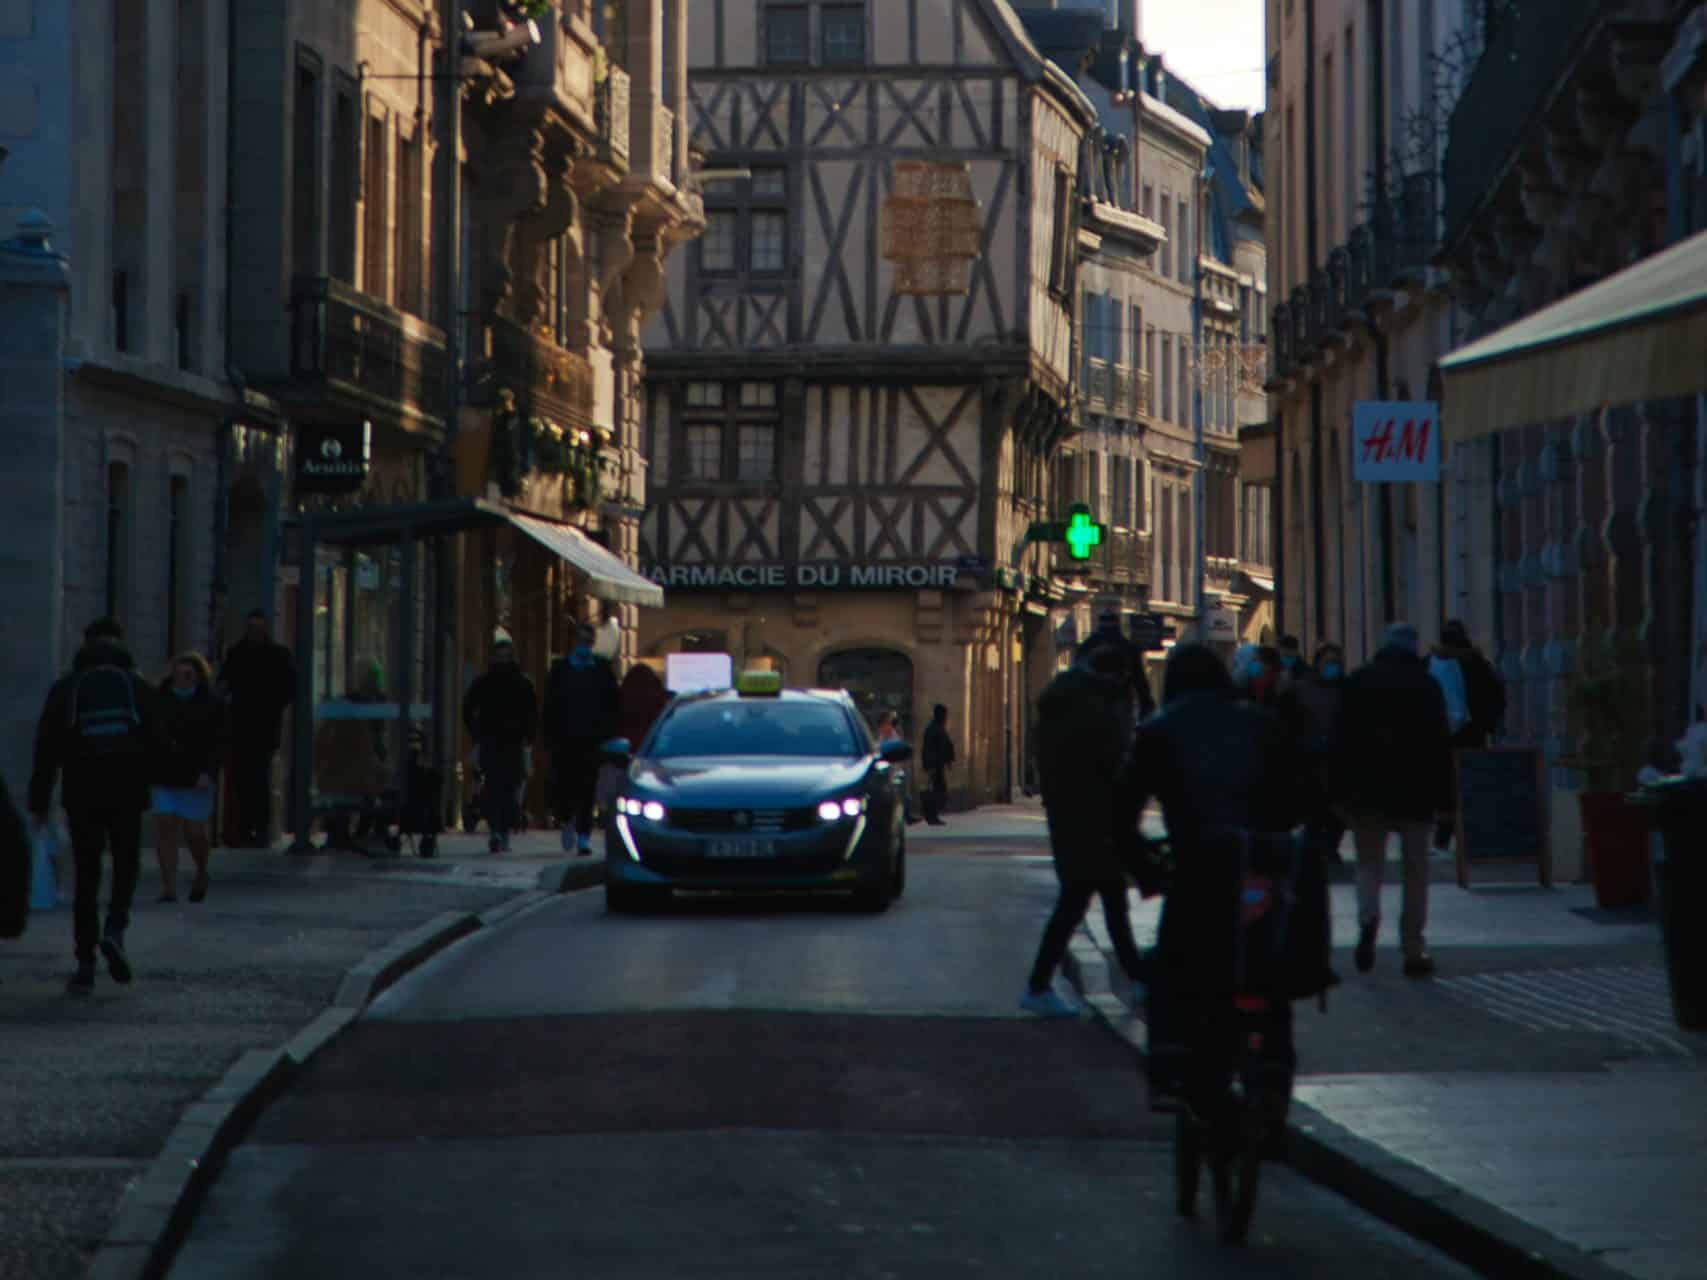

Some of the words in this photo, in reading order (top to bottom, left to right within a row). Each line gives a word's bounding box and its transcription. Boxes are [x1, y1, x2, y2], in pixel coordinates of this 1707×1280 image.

[1360, 416, 1432, 464] H&M
[797, 565, 840, 585] DU
[850, 565, 959, 585] MIROIR
